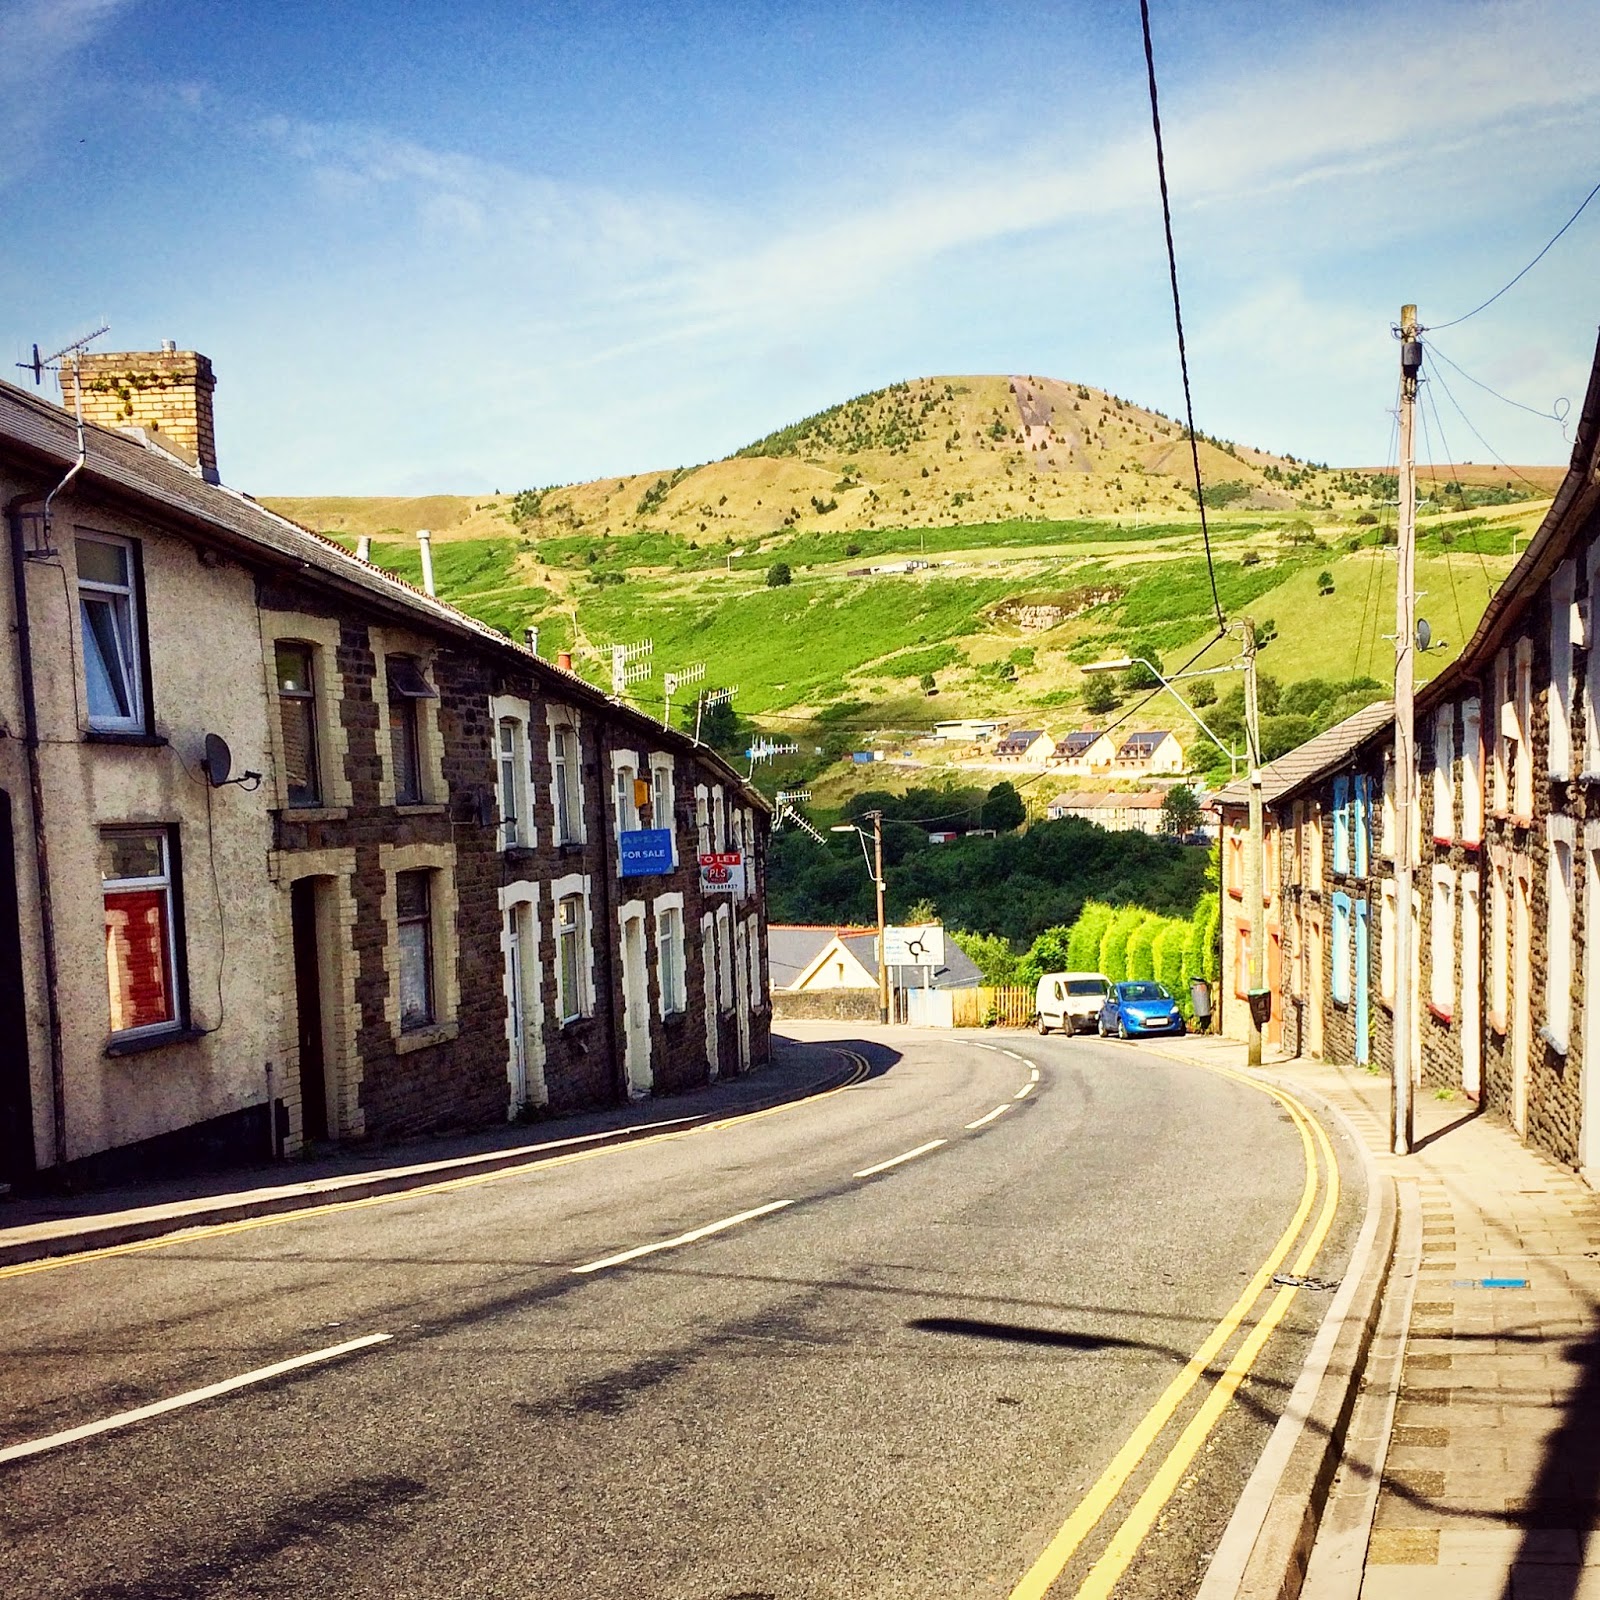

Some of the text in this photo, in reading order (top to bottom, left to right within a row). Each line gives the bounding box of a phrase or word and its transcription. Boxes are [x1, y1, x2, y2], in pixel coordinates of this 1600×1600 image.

[622, 849, 666, 859] FOR SALE
[716, 854, 738, 863] LET
[709, 868, 726, 878] PLS
